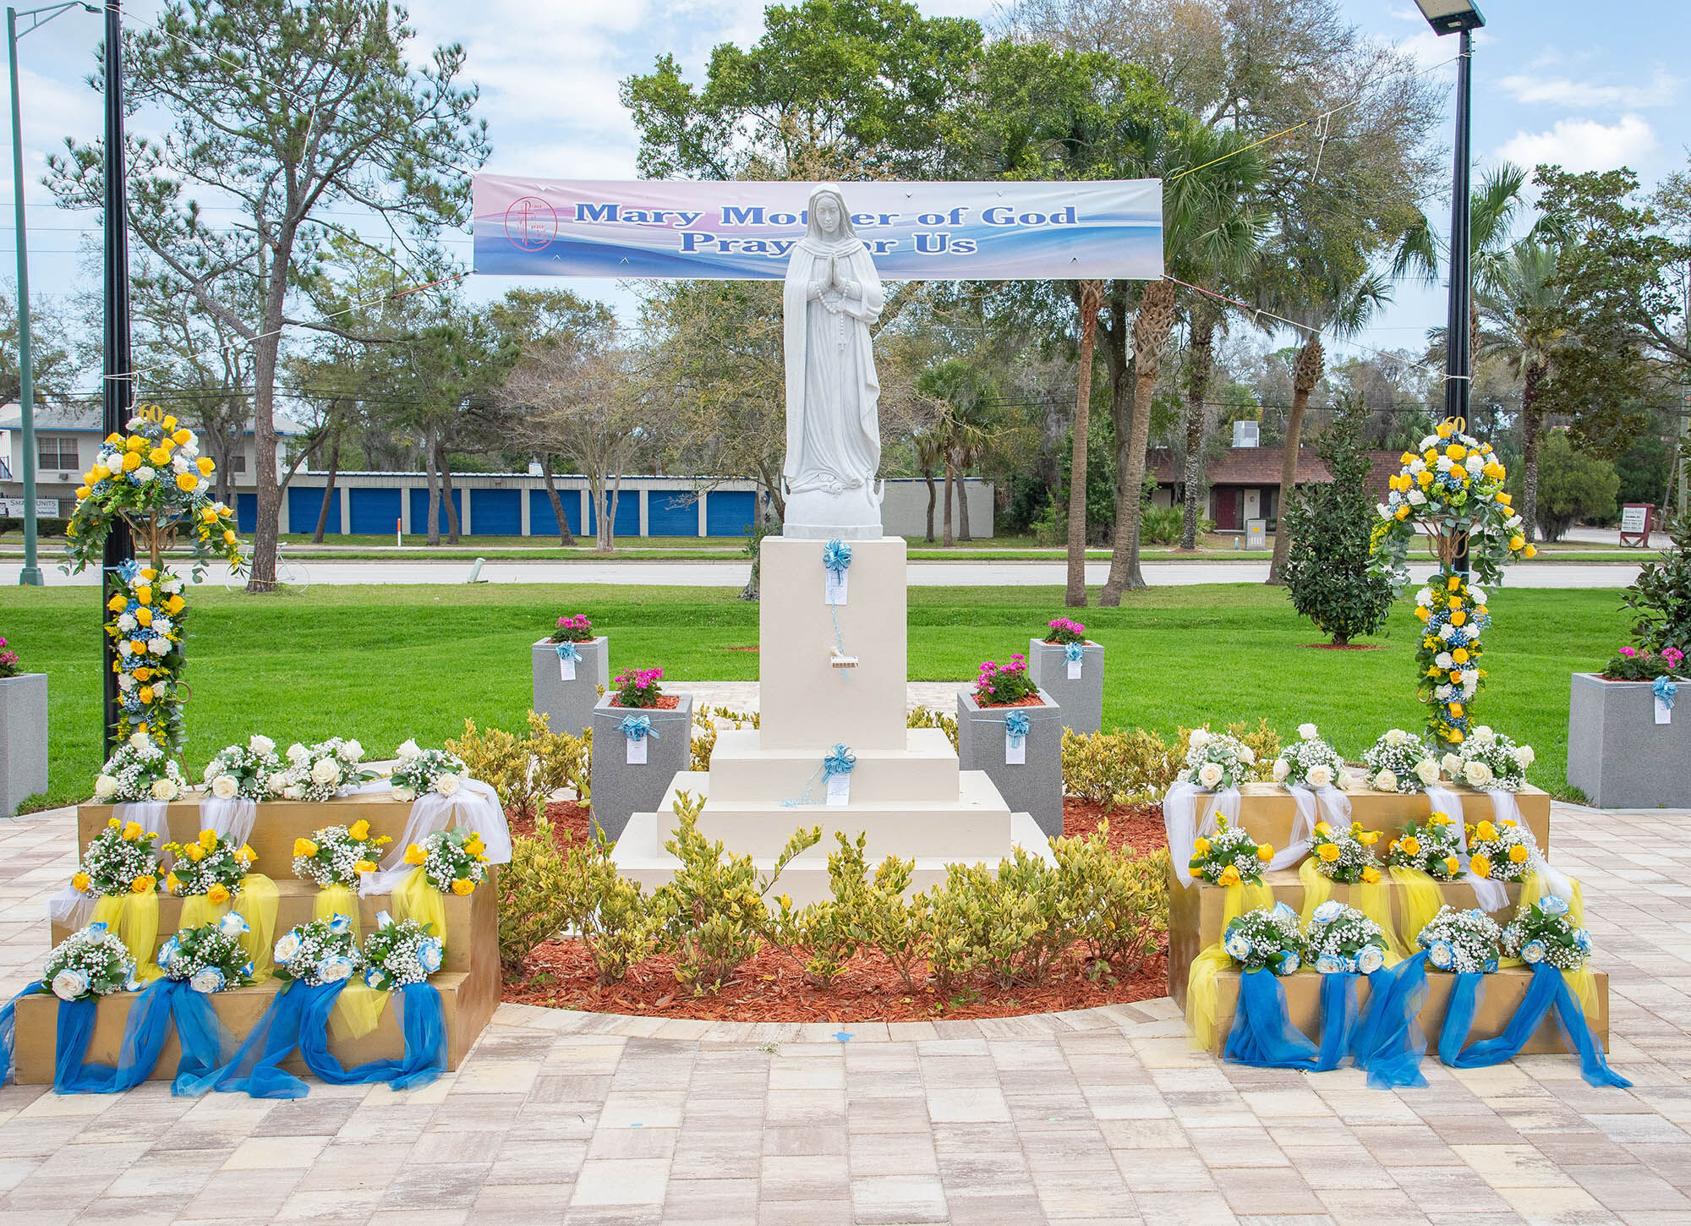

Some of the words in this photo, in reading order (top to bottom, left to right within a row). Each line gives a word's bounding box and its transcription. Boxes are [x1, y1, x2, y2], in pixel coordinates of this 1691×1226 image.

[574, 203, 703, 226] Mary
[721, 206, 900, 225] Moter
[917, 206, 969, 225] of
[982, 206, 1078, 225] God
[680, 232, 797, 256] Pray
[913, 233, 977, 253] Us
[138, 402, 163, 424] 60
